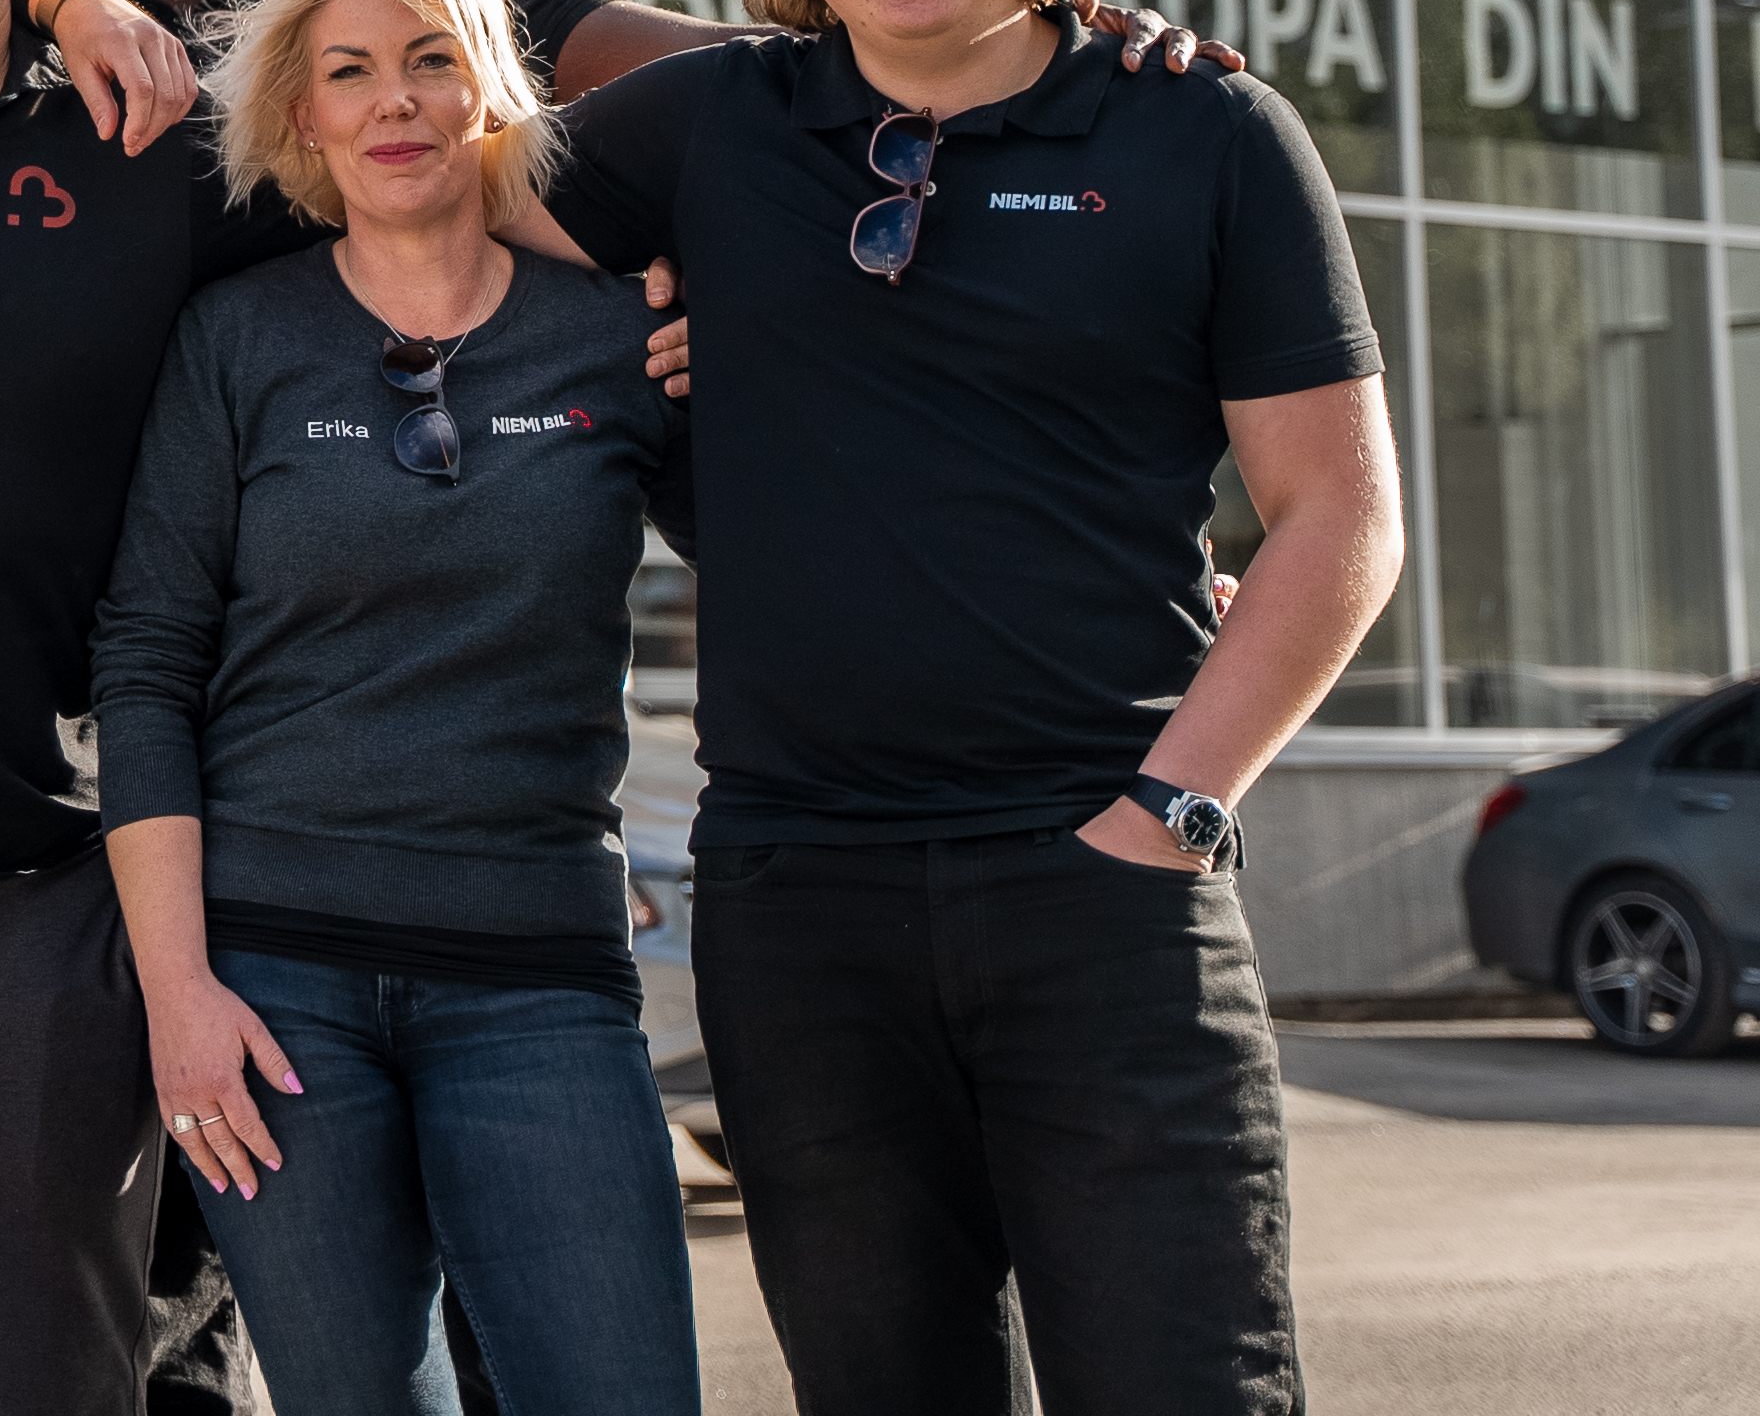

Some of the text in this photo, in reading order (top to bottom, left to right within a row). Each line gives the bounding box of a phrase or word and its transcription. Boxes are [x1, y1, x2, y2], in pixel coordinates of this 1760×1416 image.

[990, 193, 1077, 211] NIEMI BIL
[307, 420, 370, 439] Erika
[492, 413, 571, 435] NIEMI BIL
